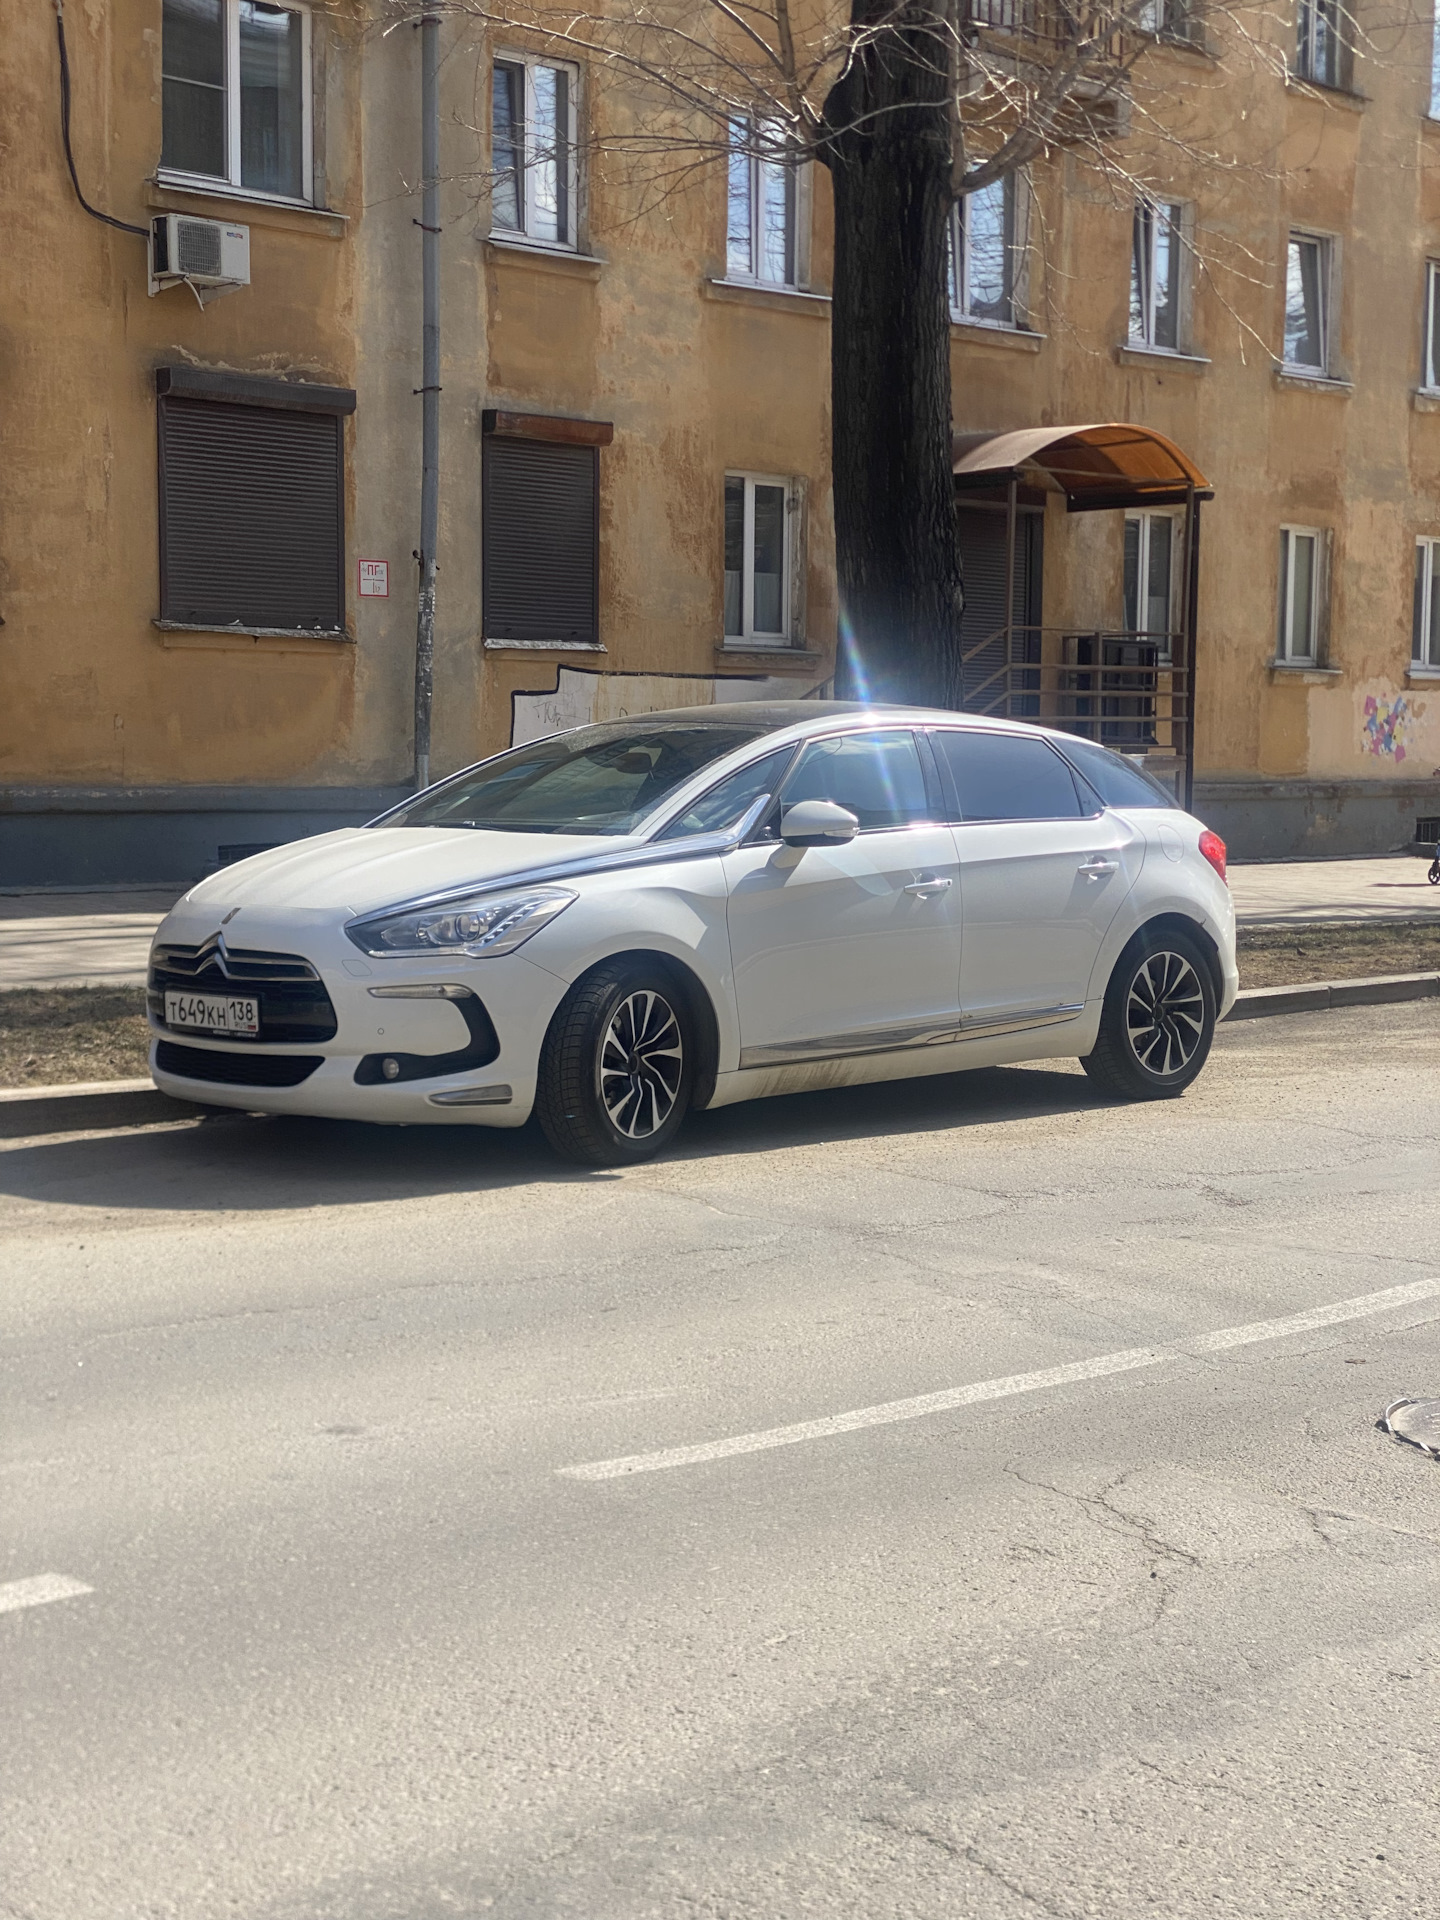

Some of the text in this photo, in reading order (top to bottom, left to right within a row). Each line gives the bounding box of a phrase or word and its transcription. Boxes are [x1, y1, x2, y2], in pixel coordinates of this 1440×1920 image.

[367, 564, 380, 575] ПГ
[169, 997, 254, 1026] Т649КН 138
